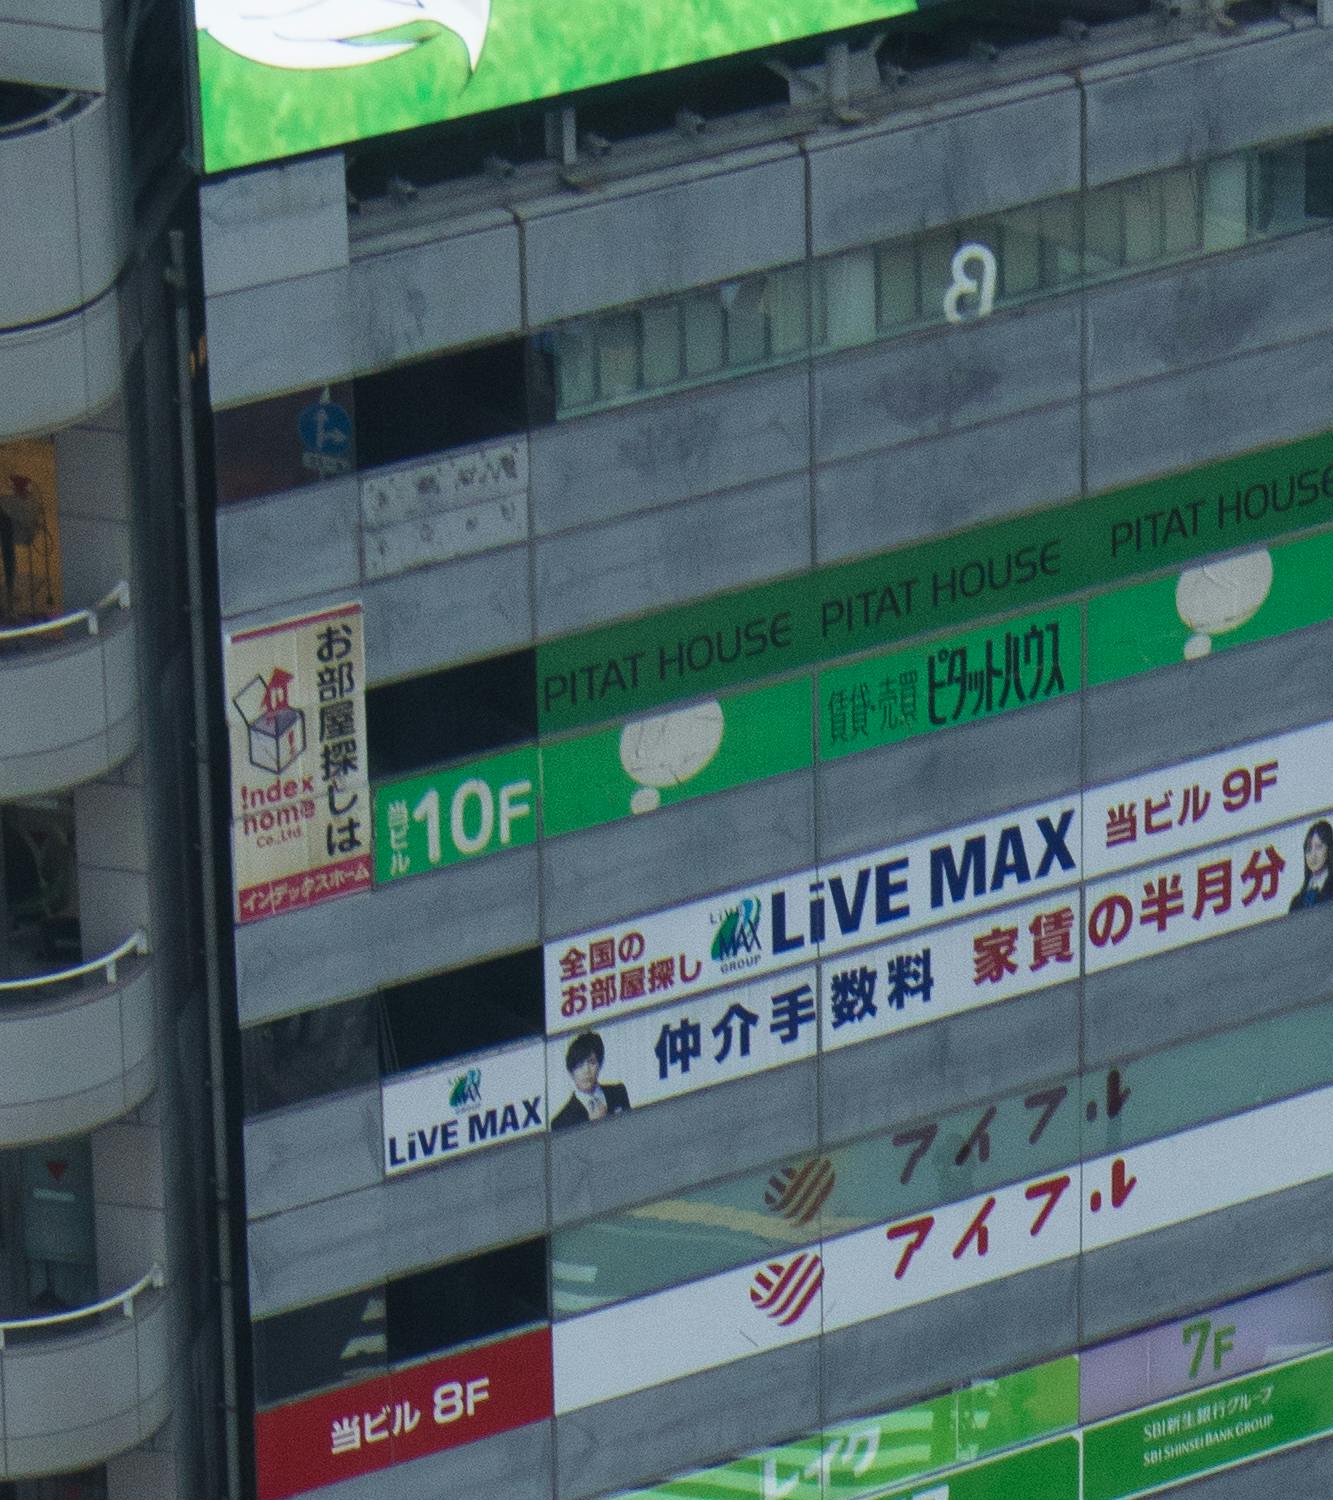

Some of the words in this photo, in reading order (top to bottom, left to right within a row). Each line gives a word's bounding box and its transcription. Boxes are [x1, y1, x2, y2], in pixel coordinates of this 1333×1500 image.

[1110, 500, 1205, 557] PITAT
[822, 579, 918, 638] PITAT
[933, 538, 1062, 607] HOUSE
[543, 653, 642, 711] PITAT
[658, 610, 793, 677] HOUSE
[927, 621, 1066, 726] ピタットハウス
[317, 623, 361, 857] お部屋探しは
[386, 799, 411, 874] 当ビル
[413, 776, 533, 863] 10F
[1105, 785, 1210, 850] 当ビル
[1222, 762, 1281, 812] 9F
[242, 861, 370, 915] インデックスホーム
[930, 809, 1076, 911] MAX
[559, 931, 646, 982] 全国の
[972, 844, 1287, 988] 家賃の半月分
[561, 952, 703, 1018] お部屋探し
[653, 947, 934, 1081] 仲介手数料
[468, 1094, 545, 1147] MAX
[892, 1065, 1132, 1186] アイフル
[886, 1156, 1138, 1281] アイフル
[1181, 1318, 1238, 1380] 7F
[331, 1398, 421, 1456] 当ビル
[432, 1376, 492, 1427] 8F
